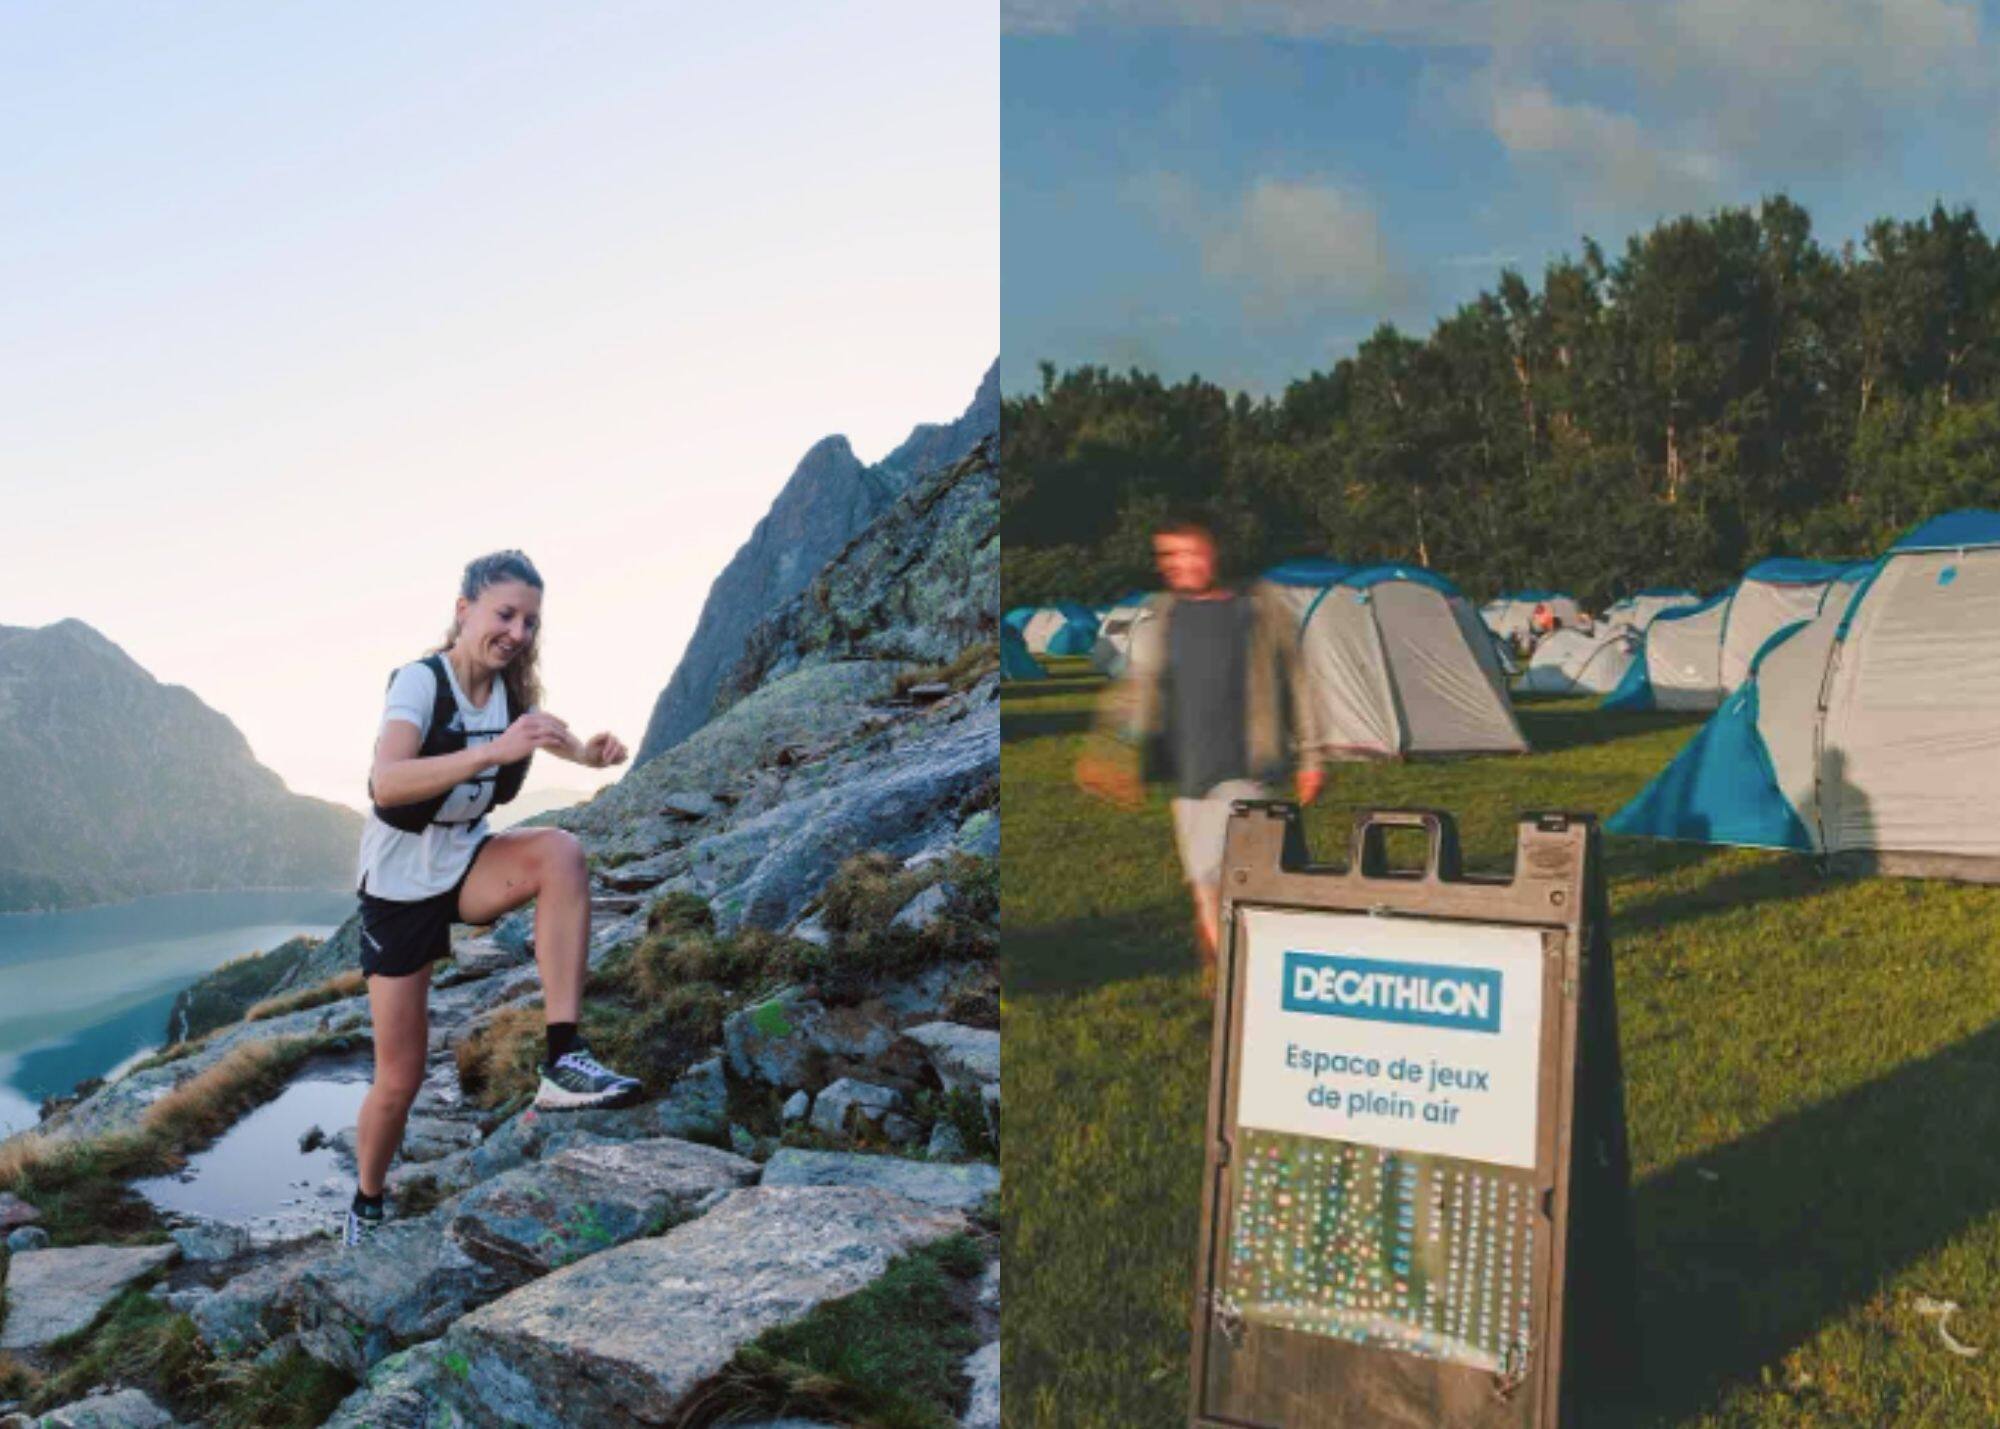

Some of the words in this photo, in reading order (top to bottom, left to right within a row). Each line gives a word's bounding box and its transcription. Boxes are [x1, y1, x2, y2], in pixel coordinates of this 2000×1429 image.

[1293, 965, 1489, 1019] DECATHLON
[1286, 1043, 1380, 1078] Espace
[1387, 1056, 1423, 1084] de
[1428, 1060, 1489, 1092] jeux
[1307, 1084, 1341, 1110] de
[1347, 1089, 1415, 1119] plein
[1422, 1099, 1460, 1125] air
